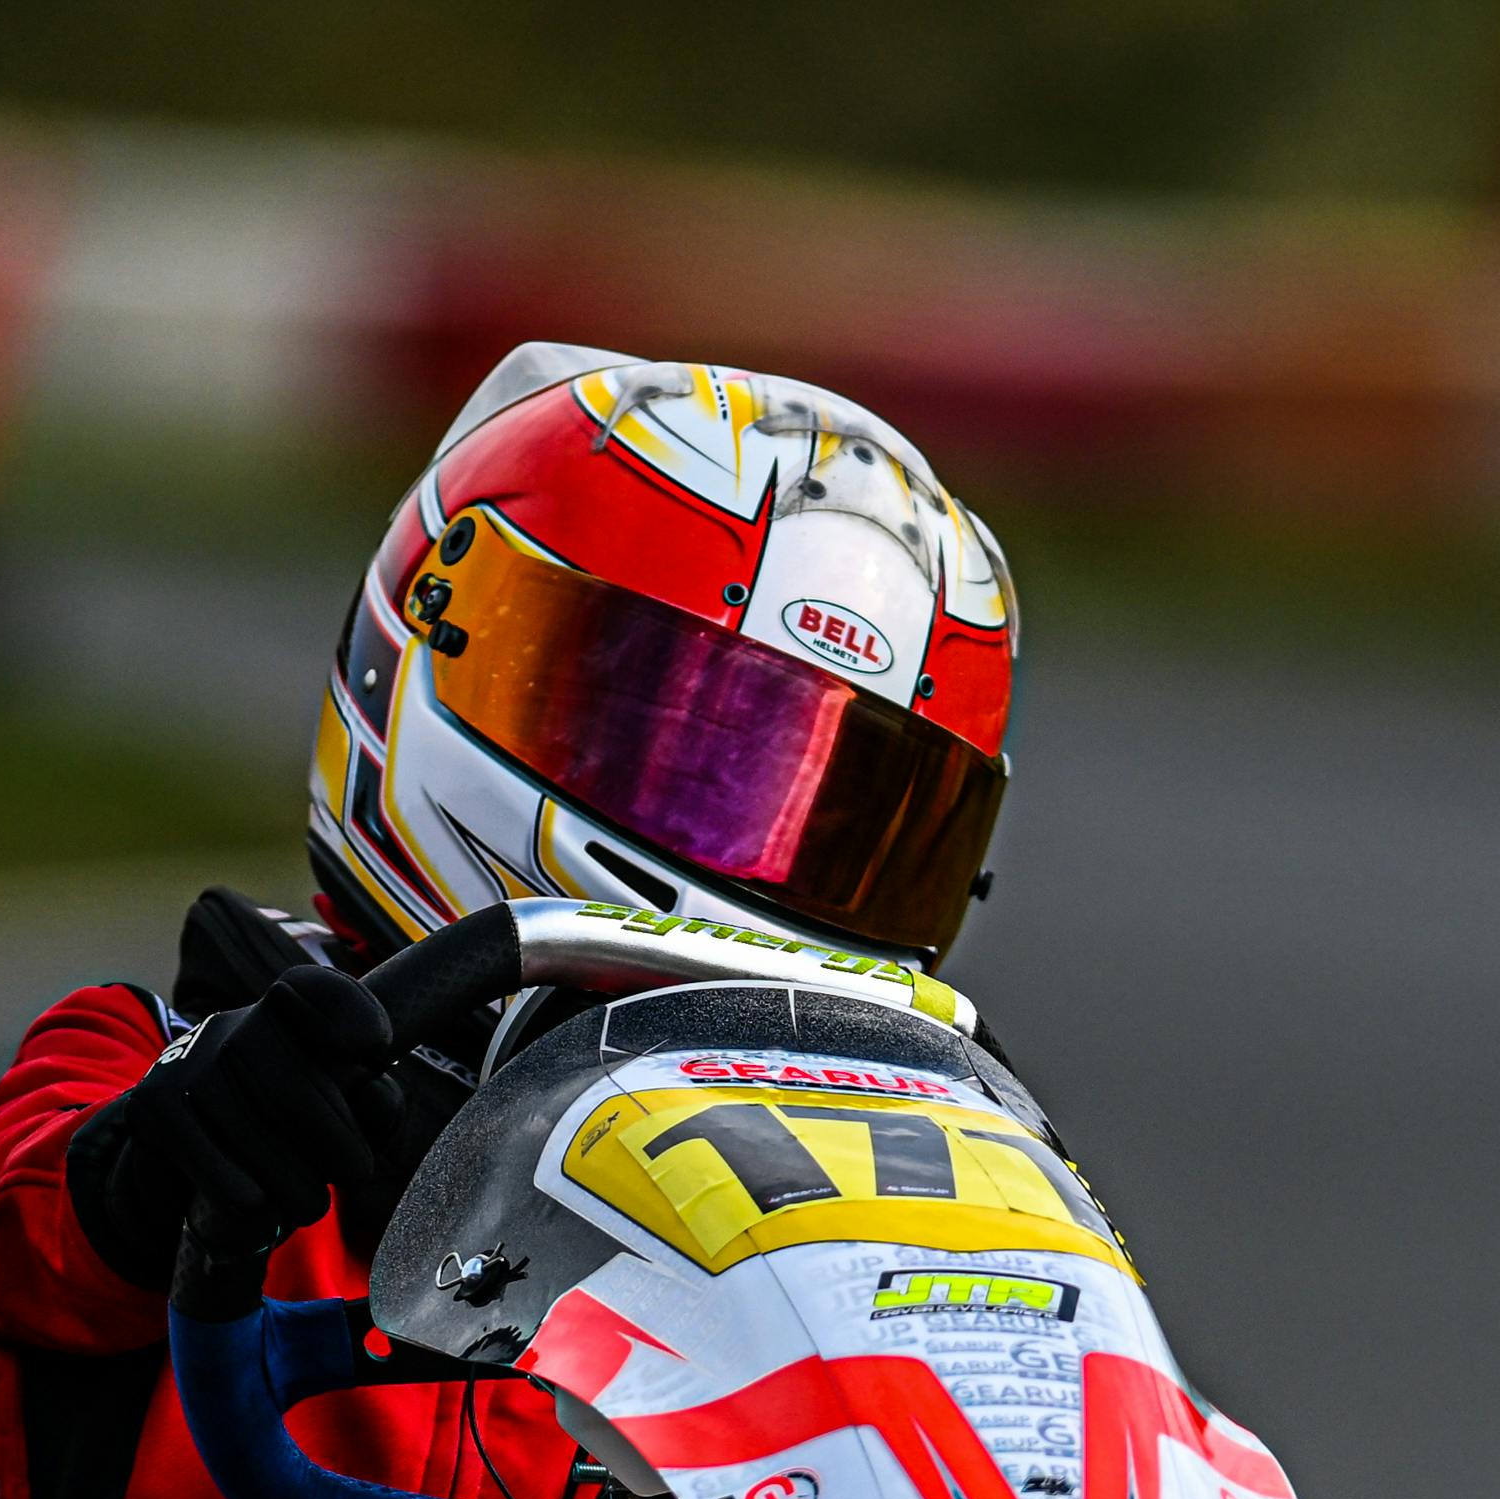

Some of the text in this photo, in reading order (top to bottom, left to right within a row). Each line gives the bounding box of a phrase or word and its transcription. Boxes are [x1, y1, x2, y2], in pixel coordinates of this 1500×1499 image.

[797, 603, 880, 665] BELL
[813, 638, 859, 664] HELMETS
[680, 1058, 952, 1097] GEARUP
[872, 1274, 1055, 1309] JTR
